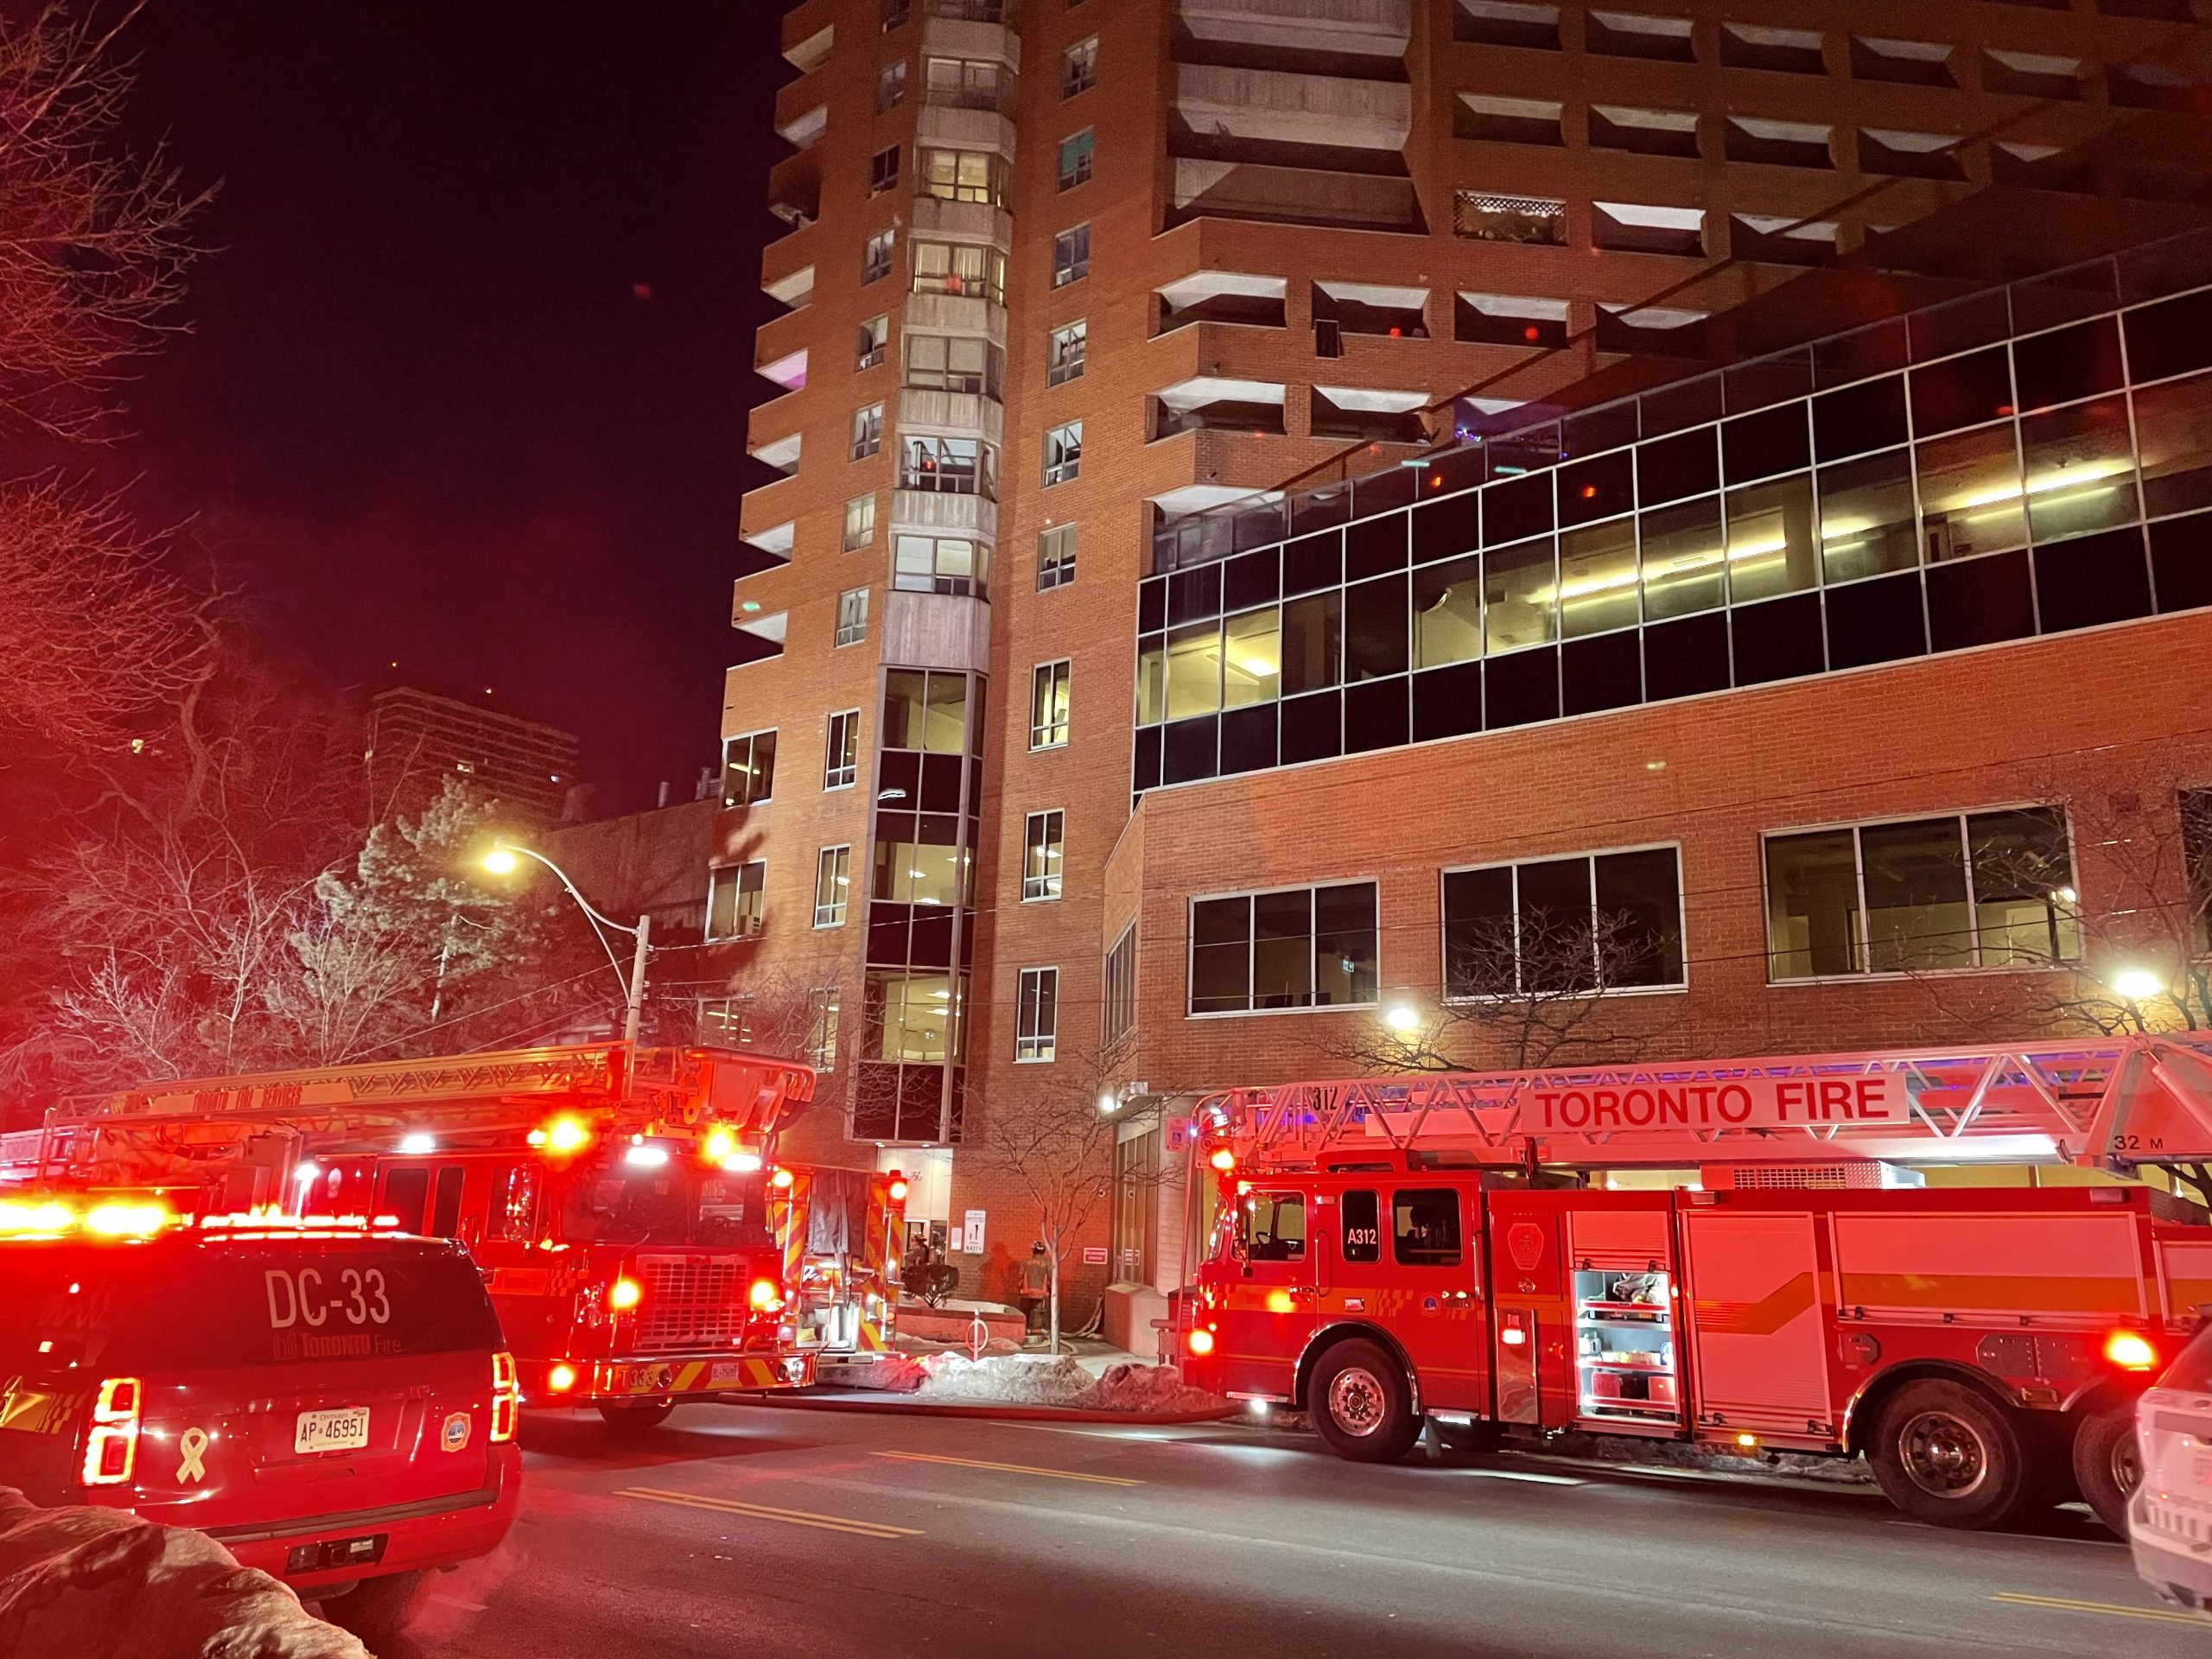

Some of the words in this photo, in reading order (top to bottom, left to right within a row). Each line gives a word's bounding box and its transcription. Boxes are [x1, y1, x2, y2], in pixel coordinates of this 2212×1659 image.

[1535, 1084, 1752, 1128] TORONTO
[1776, 1079, 1890, 1122] FIRE
[2113, 1135, 2141, 1150] 32
[2149, 1138, 2164, 1149] M
[1347, 1228, 1376, 1244] A312
[264, 1268, 390, 1328] DC-33
[374, 1334, 402, 1354] Fire
[325, 1417, 364, 1439] 46951
